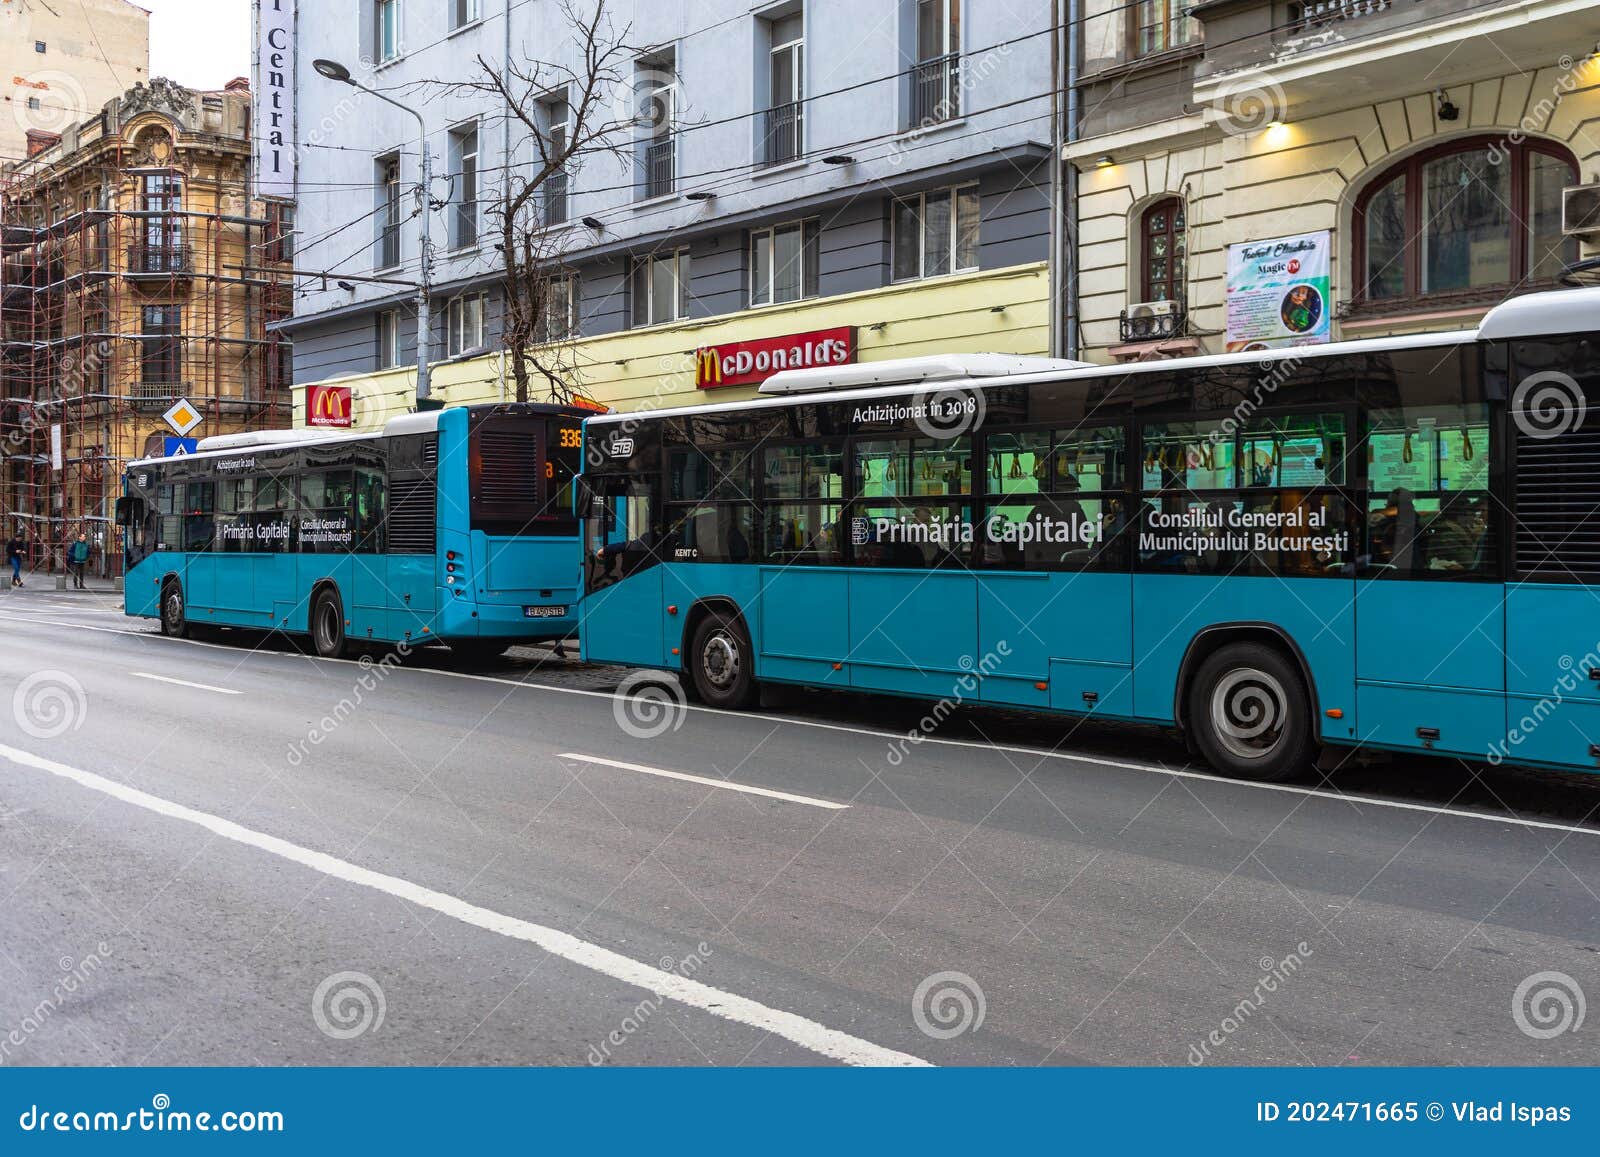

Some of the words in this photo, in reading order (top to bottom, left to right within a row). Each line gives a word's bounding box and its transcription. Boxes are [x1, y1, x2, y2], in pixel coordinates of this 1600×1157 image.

[267, 28, 287, 173] Central
[1257, 263, 1286, 275] Magic
[696, 338, 847, 384] McDonald's
[930, 400, 943, 417] în
[946, 397, 976, 416] 2018
[559, 429, 582, 448] 336
[611, 440, 633, 457] STB
[321, 518, 341, 529] General
[1148, 507, 1223, 528] Consiliul
[1228, 506, 1303, 527] General
[1308, 506, 1326, 527] al
[223, 522, 254, 539] Primăria
[256, 521, 290, 543] Capitalei
[876, 514, 974, 543] Primăria
[986, 512, 1103, 550] Capitalei
[674, 548, 691, 557] KENT
[692, 548, 698, 557] C
[1139, 531, 1249, 556] Municipiului
[1254, 530, 1349, 558] București
